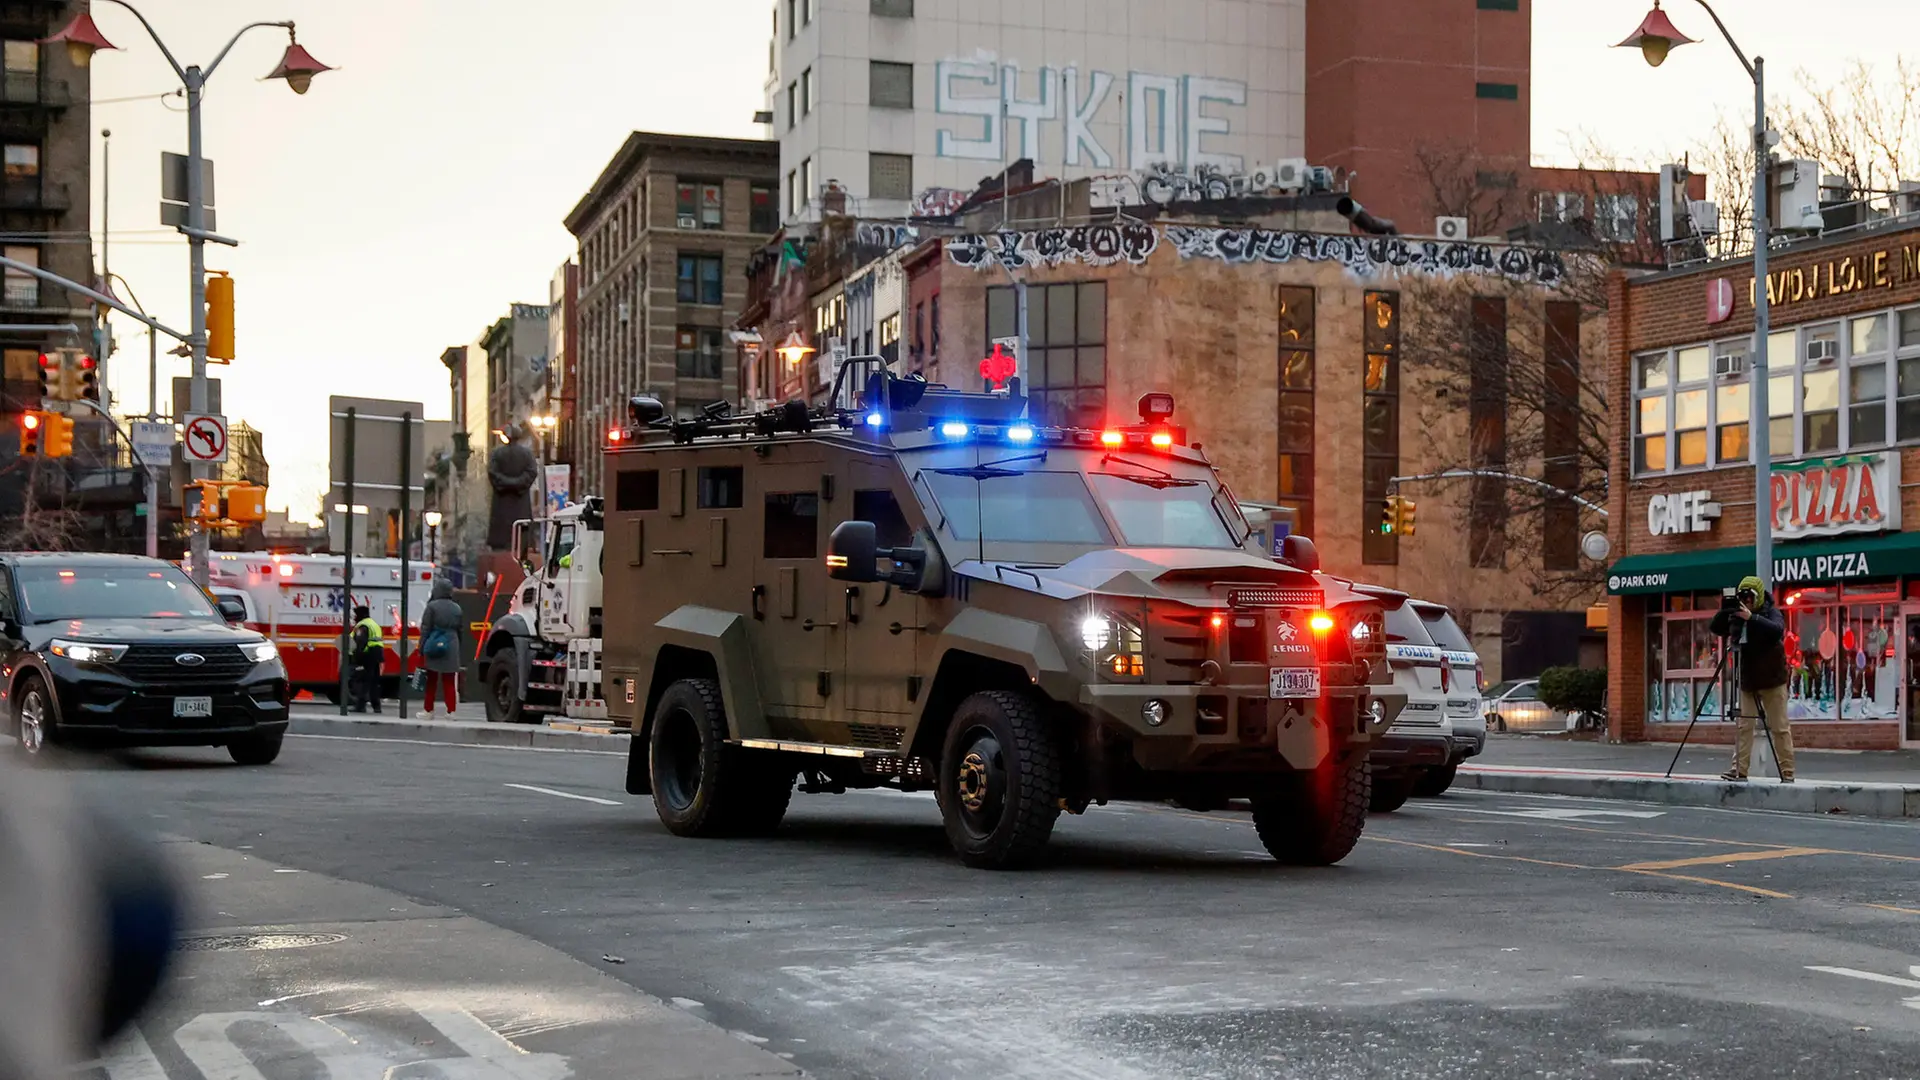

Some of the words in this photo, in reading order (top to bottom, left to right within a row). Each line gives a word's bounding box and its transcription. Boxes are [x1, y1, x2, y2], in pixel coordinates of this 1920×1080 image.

[1770, 464, 1881, 528] PIZZA
[1648, 490, 1711, 536] CAFE
[1772, 558, 1811, 582] UNA
[1816, 553, 1869, 578] PIZZA
[1621, 576, 1644, 588] PARK
[1646, 573, 1668, 586] ROW
[1397, 647, 1435, 658] POLICE
[1448, 652, 1470, 662] LICE
[1276, 674, 1314, 689] J134307
